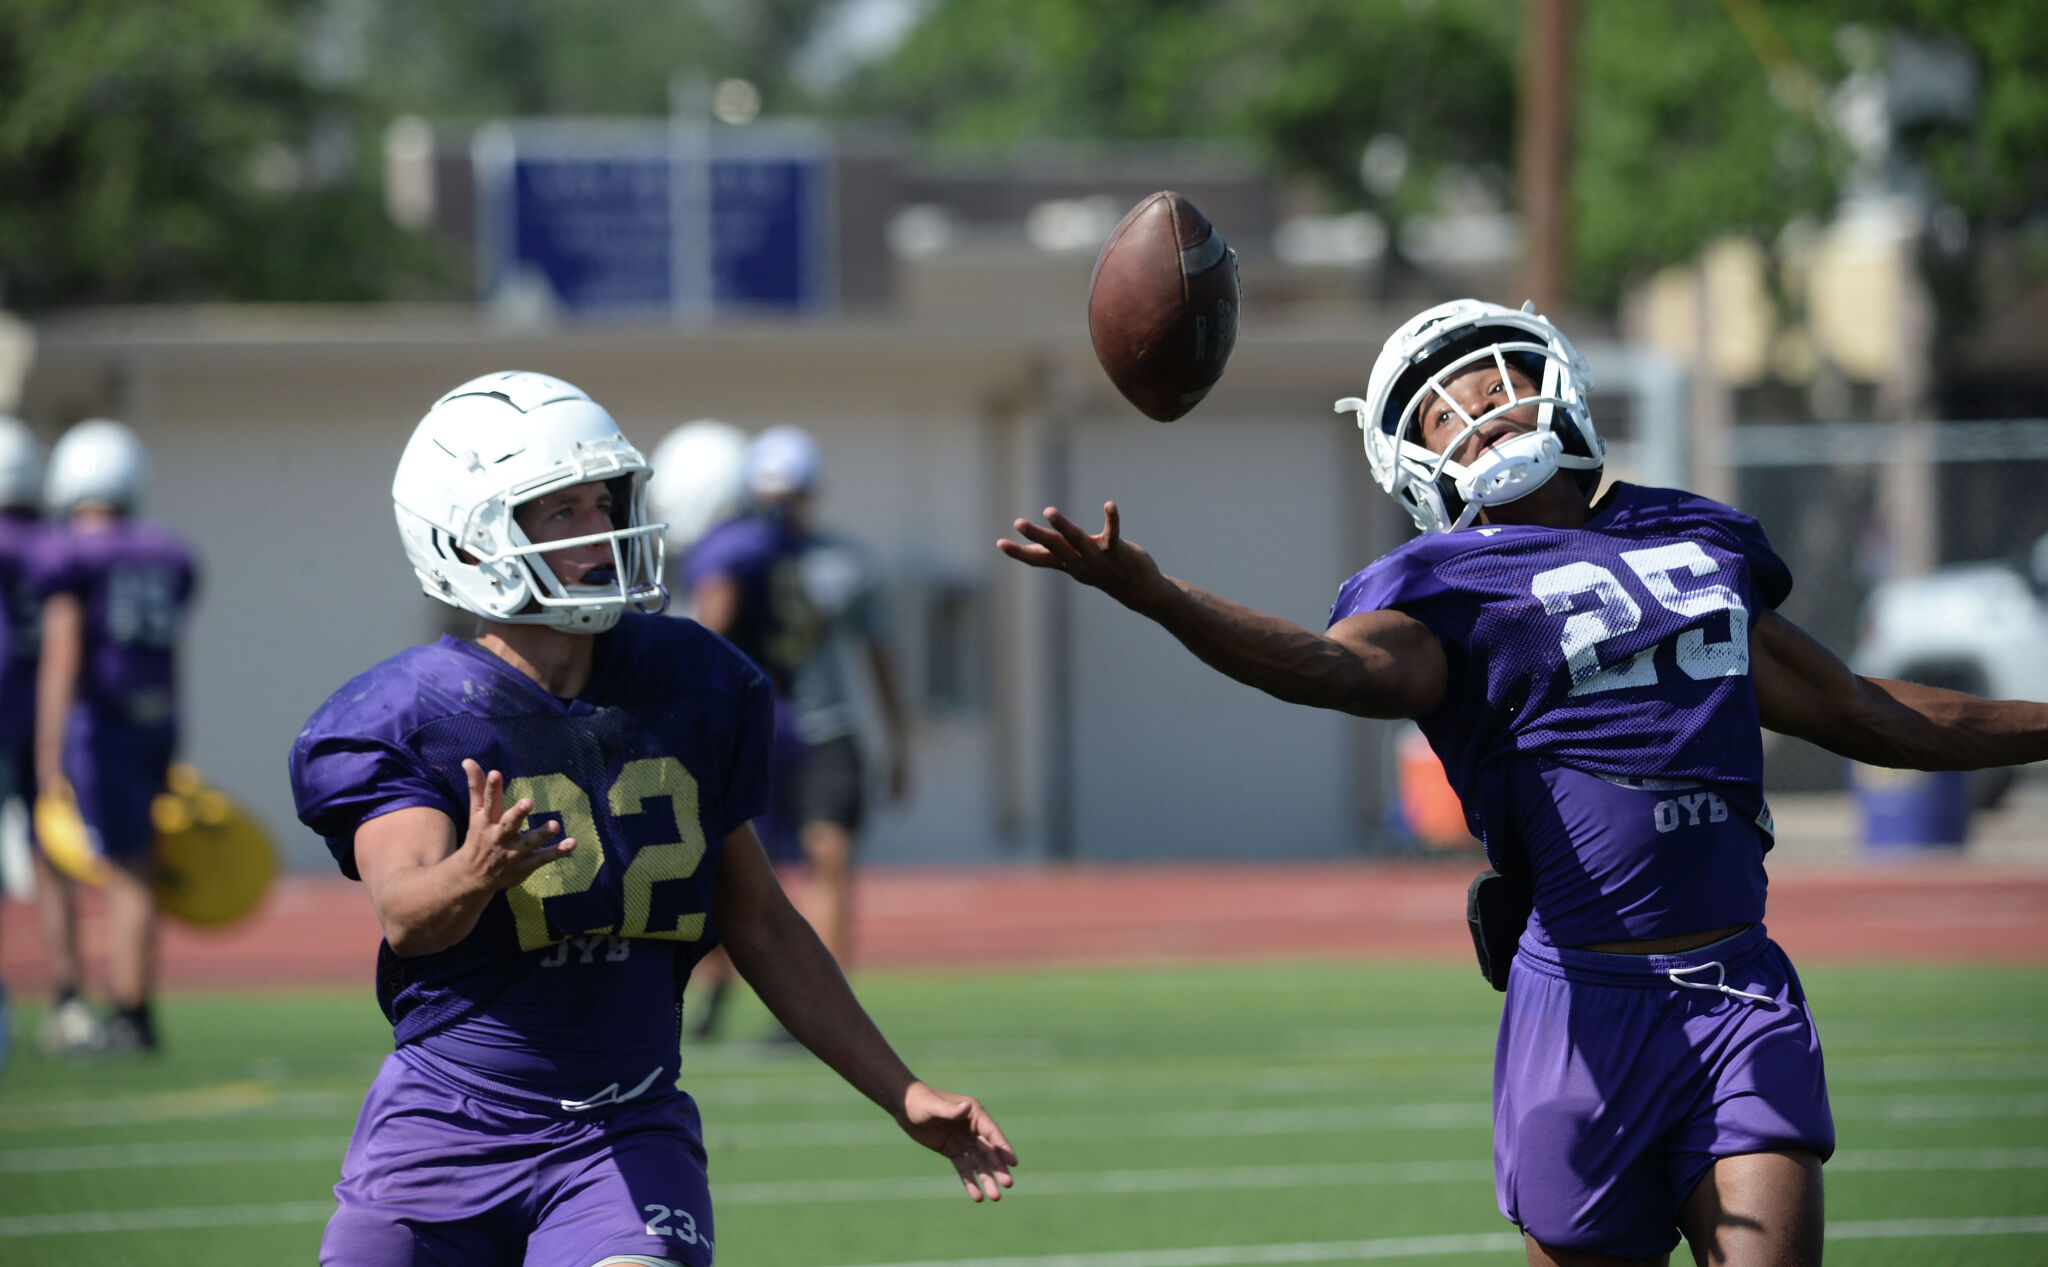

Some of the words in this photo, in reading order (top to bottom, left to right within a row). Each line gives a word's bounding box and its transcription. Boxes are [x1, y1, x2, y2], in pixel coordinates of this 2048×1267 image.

[1531, 540, 1749, 697] 25
[503, 756, 707, 952] 22
[1653, 791, 1728, 833] OYB
